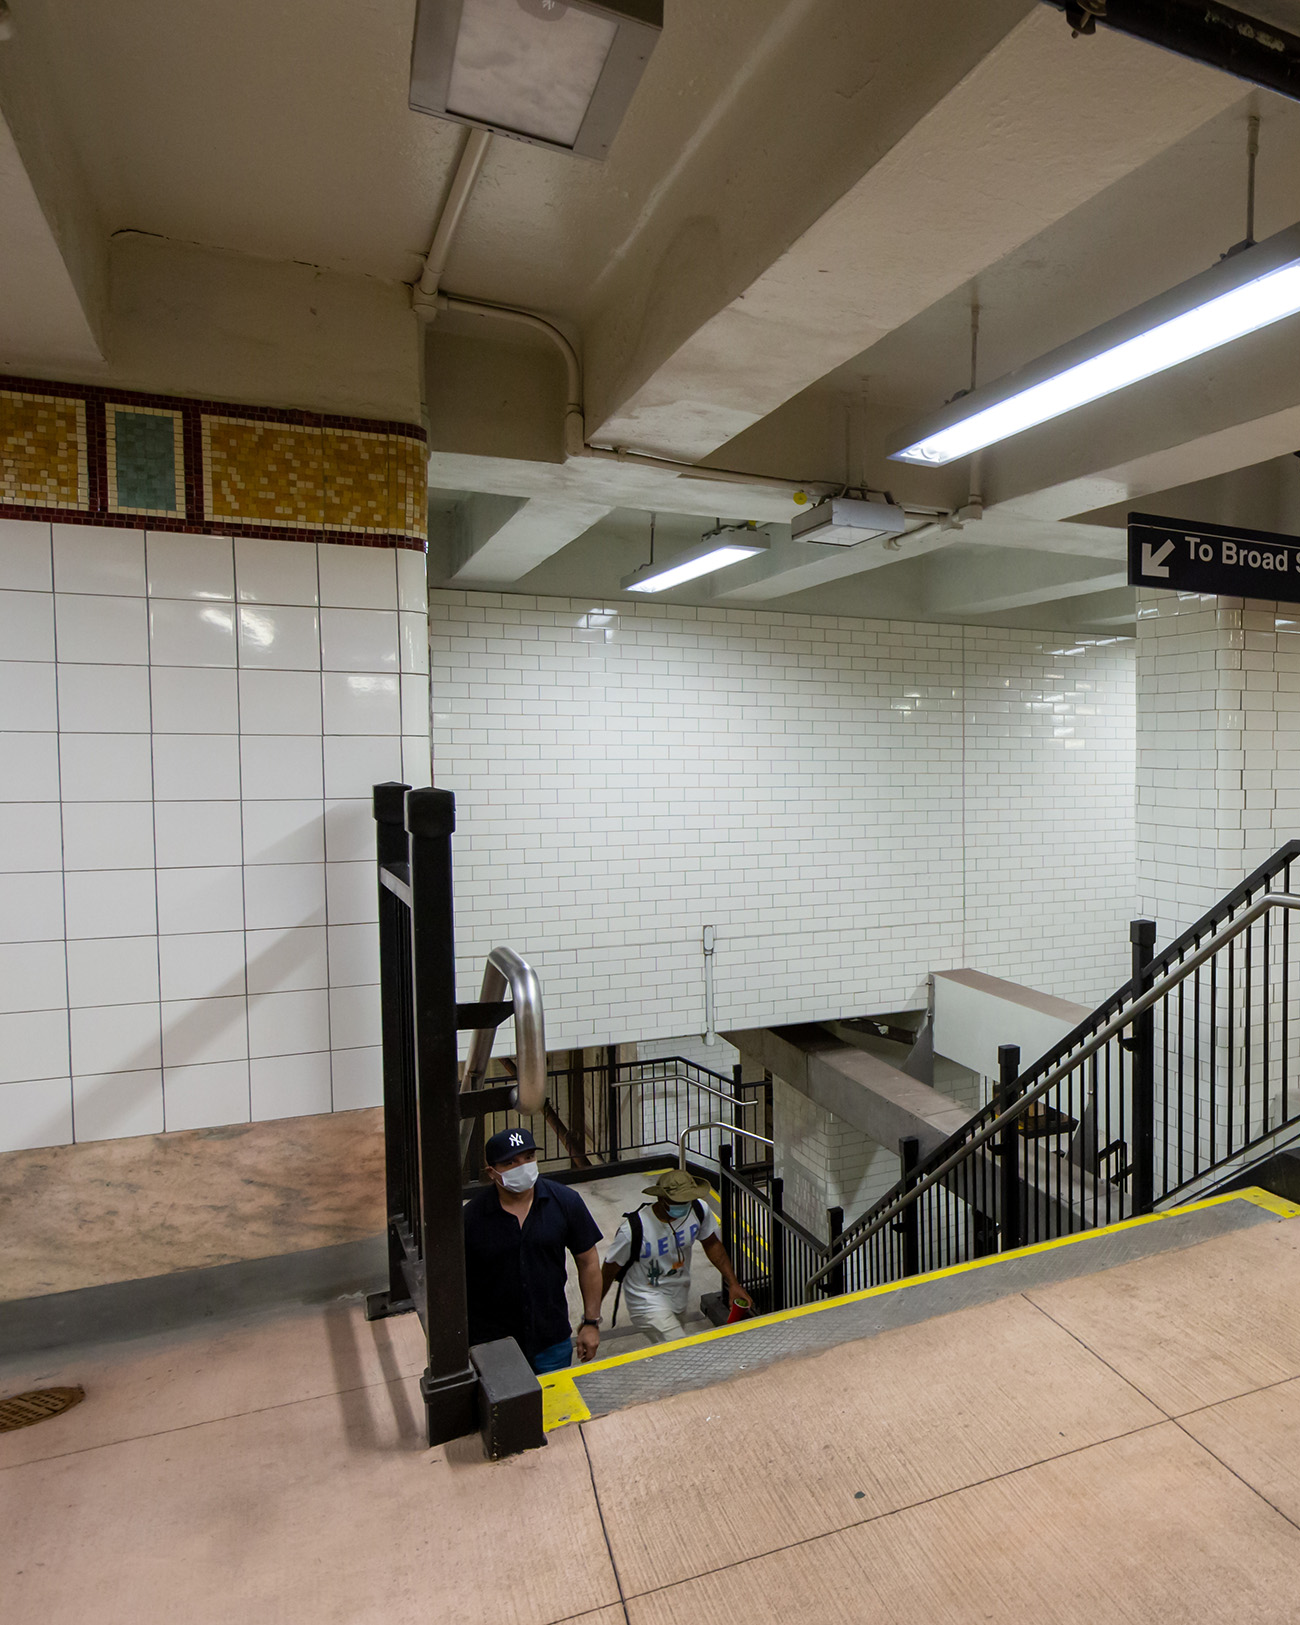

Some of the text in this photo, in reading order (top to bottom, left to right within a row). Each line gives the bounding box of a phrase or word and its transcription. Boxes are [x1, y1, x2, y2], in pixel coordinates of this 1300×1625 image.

[1185, 536, 1213, 562] To
[1222, 541, 1288, 572] Broad
[640, 1223, 699, 1259] JEEP
